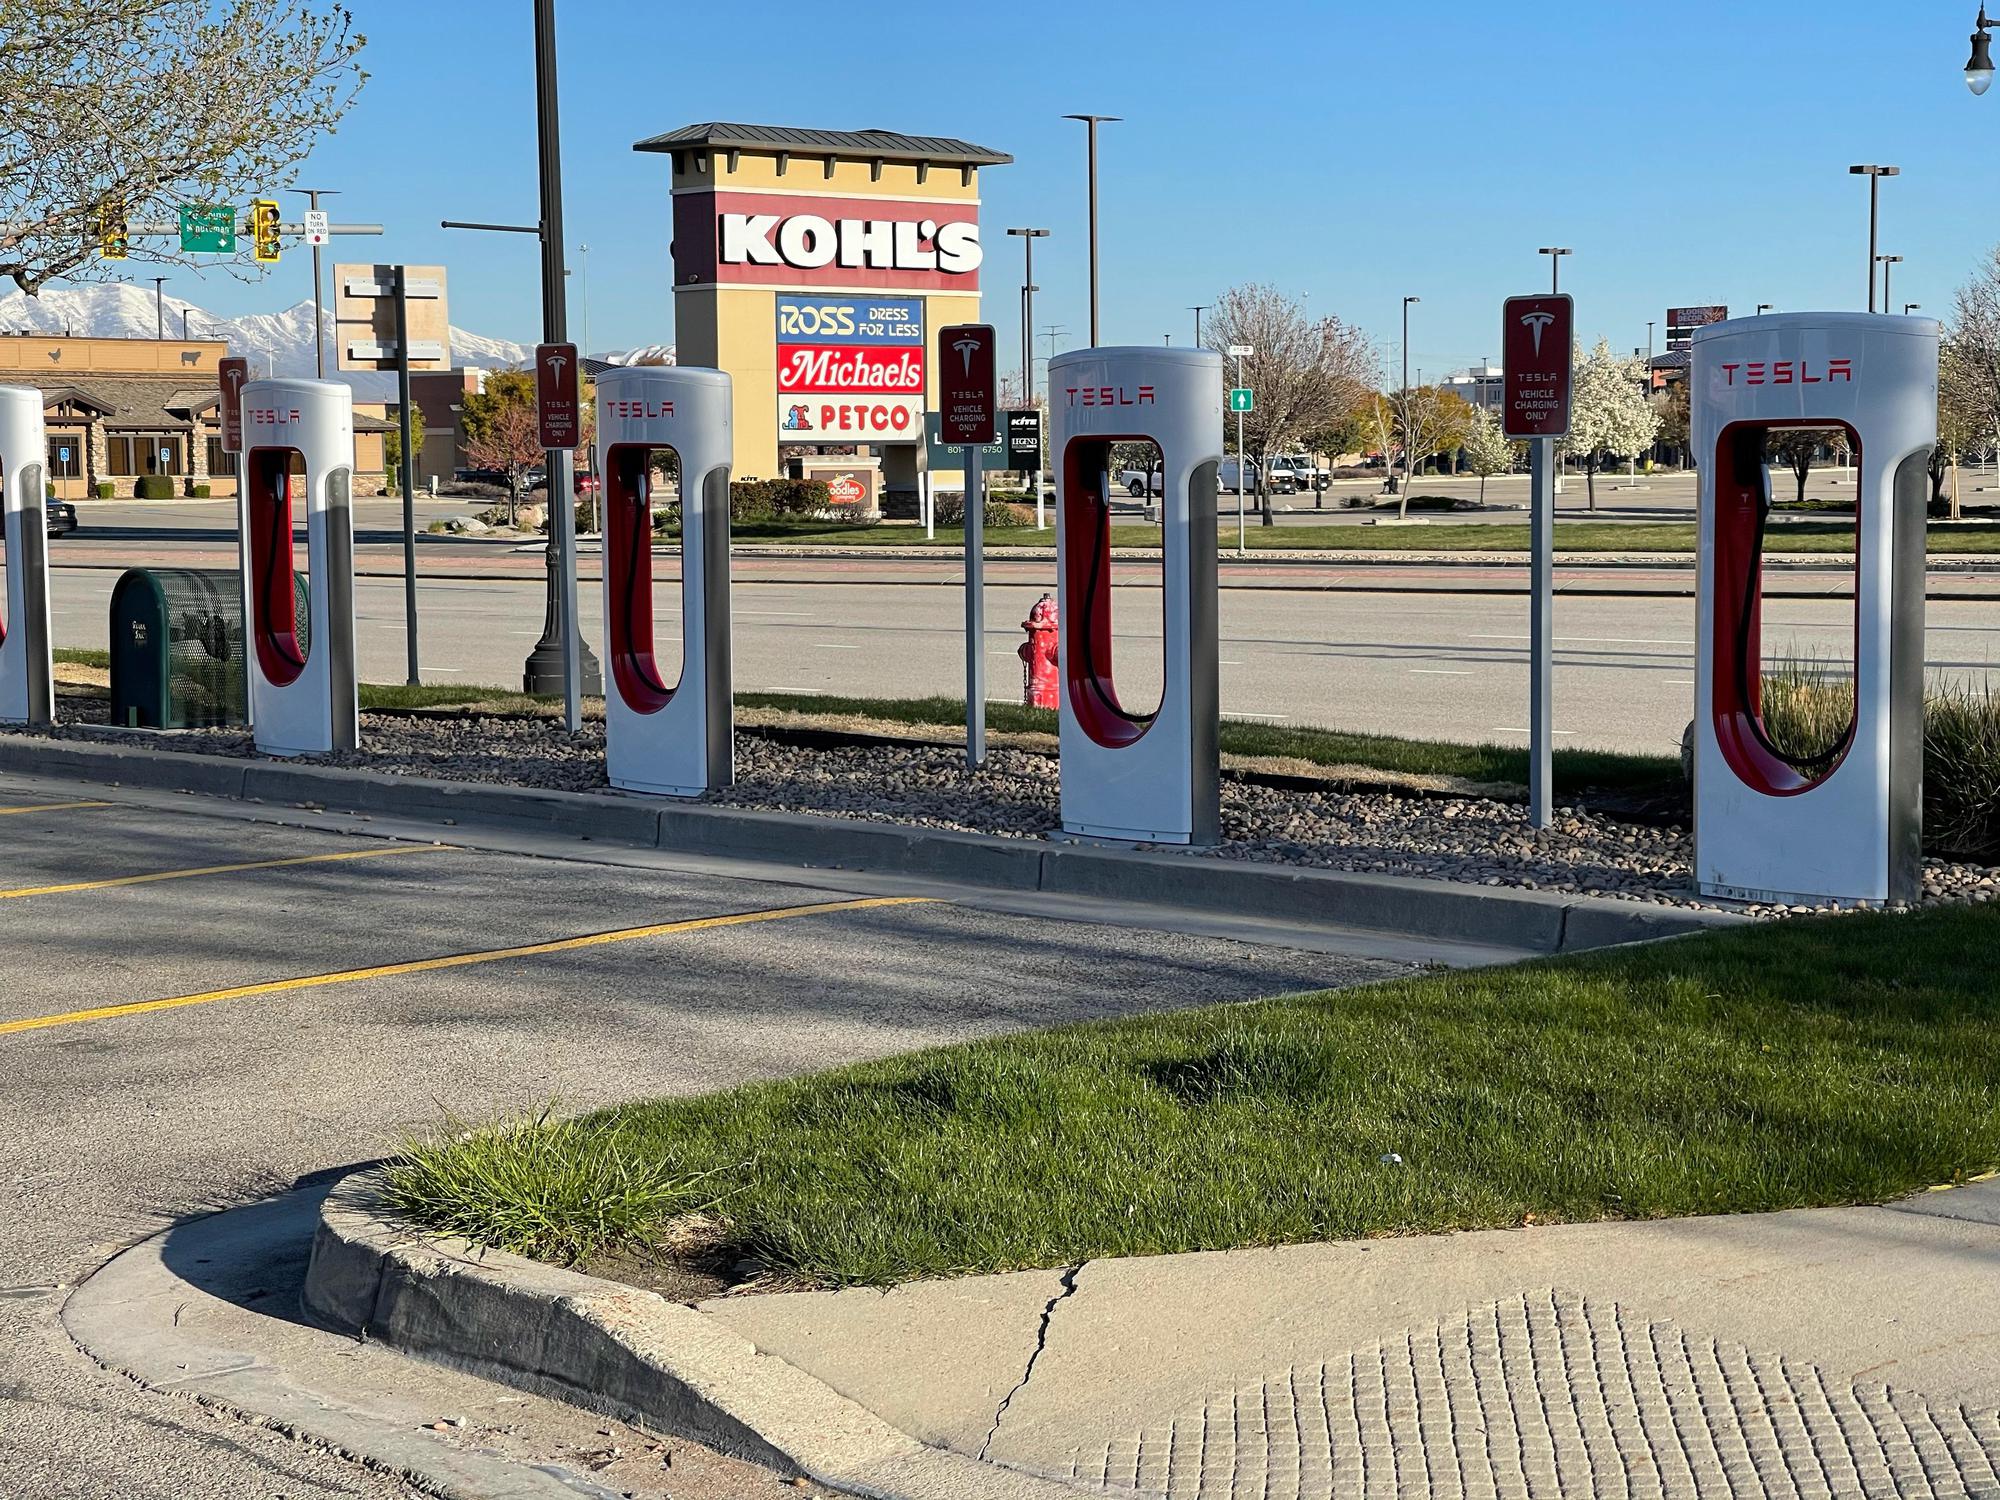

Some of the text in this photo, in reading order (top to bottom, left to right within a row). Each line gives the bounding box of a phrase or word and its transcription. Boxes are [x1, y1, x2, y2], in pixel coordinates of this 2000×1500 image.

[718, 213, 983, 275] KOHL'S
[869, 307, 909, 320] DRESS
[780, 305, 855, 335] ROSS
[859, 323, 919, 337] FOR LESS
[780, 350, 920, 387] Michaels
[1722, 359, 1851, 386] TESLA
[1518, 372, 1557, 382] TESLA
[951, 390, 984, 399] TESLA
[1066, 386, 1154, 407] TESLA
[1519, 389, 1554, 399] VEHICLE
[607, 401, 674, 418] TESLA
[953, 405, 982, 413] VEHICLE
[1514, 400, 1559, 409] CHARGING
[247, 409, 300, 424] TESLA
[547, 413, 570, 421] VEHICLE
[820, 404, 910, 431] PETCO
[949, 414, 986, 422] CHARGING
[1525, 411, 1548, 420] ONLY
[958, 423, 977, 431] ONLY
[551, 429, 566, 437] ONLY
[1011, 437, 1038, 445] LEGEND
[828, 482, 860, 495] oodles
